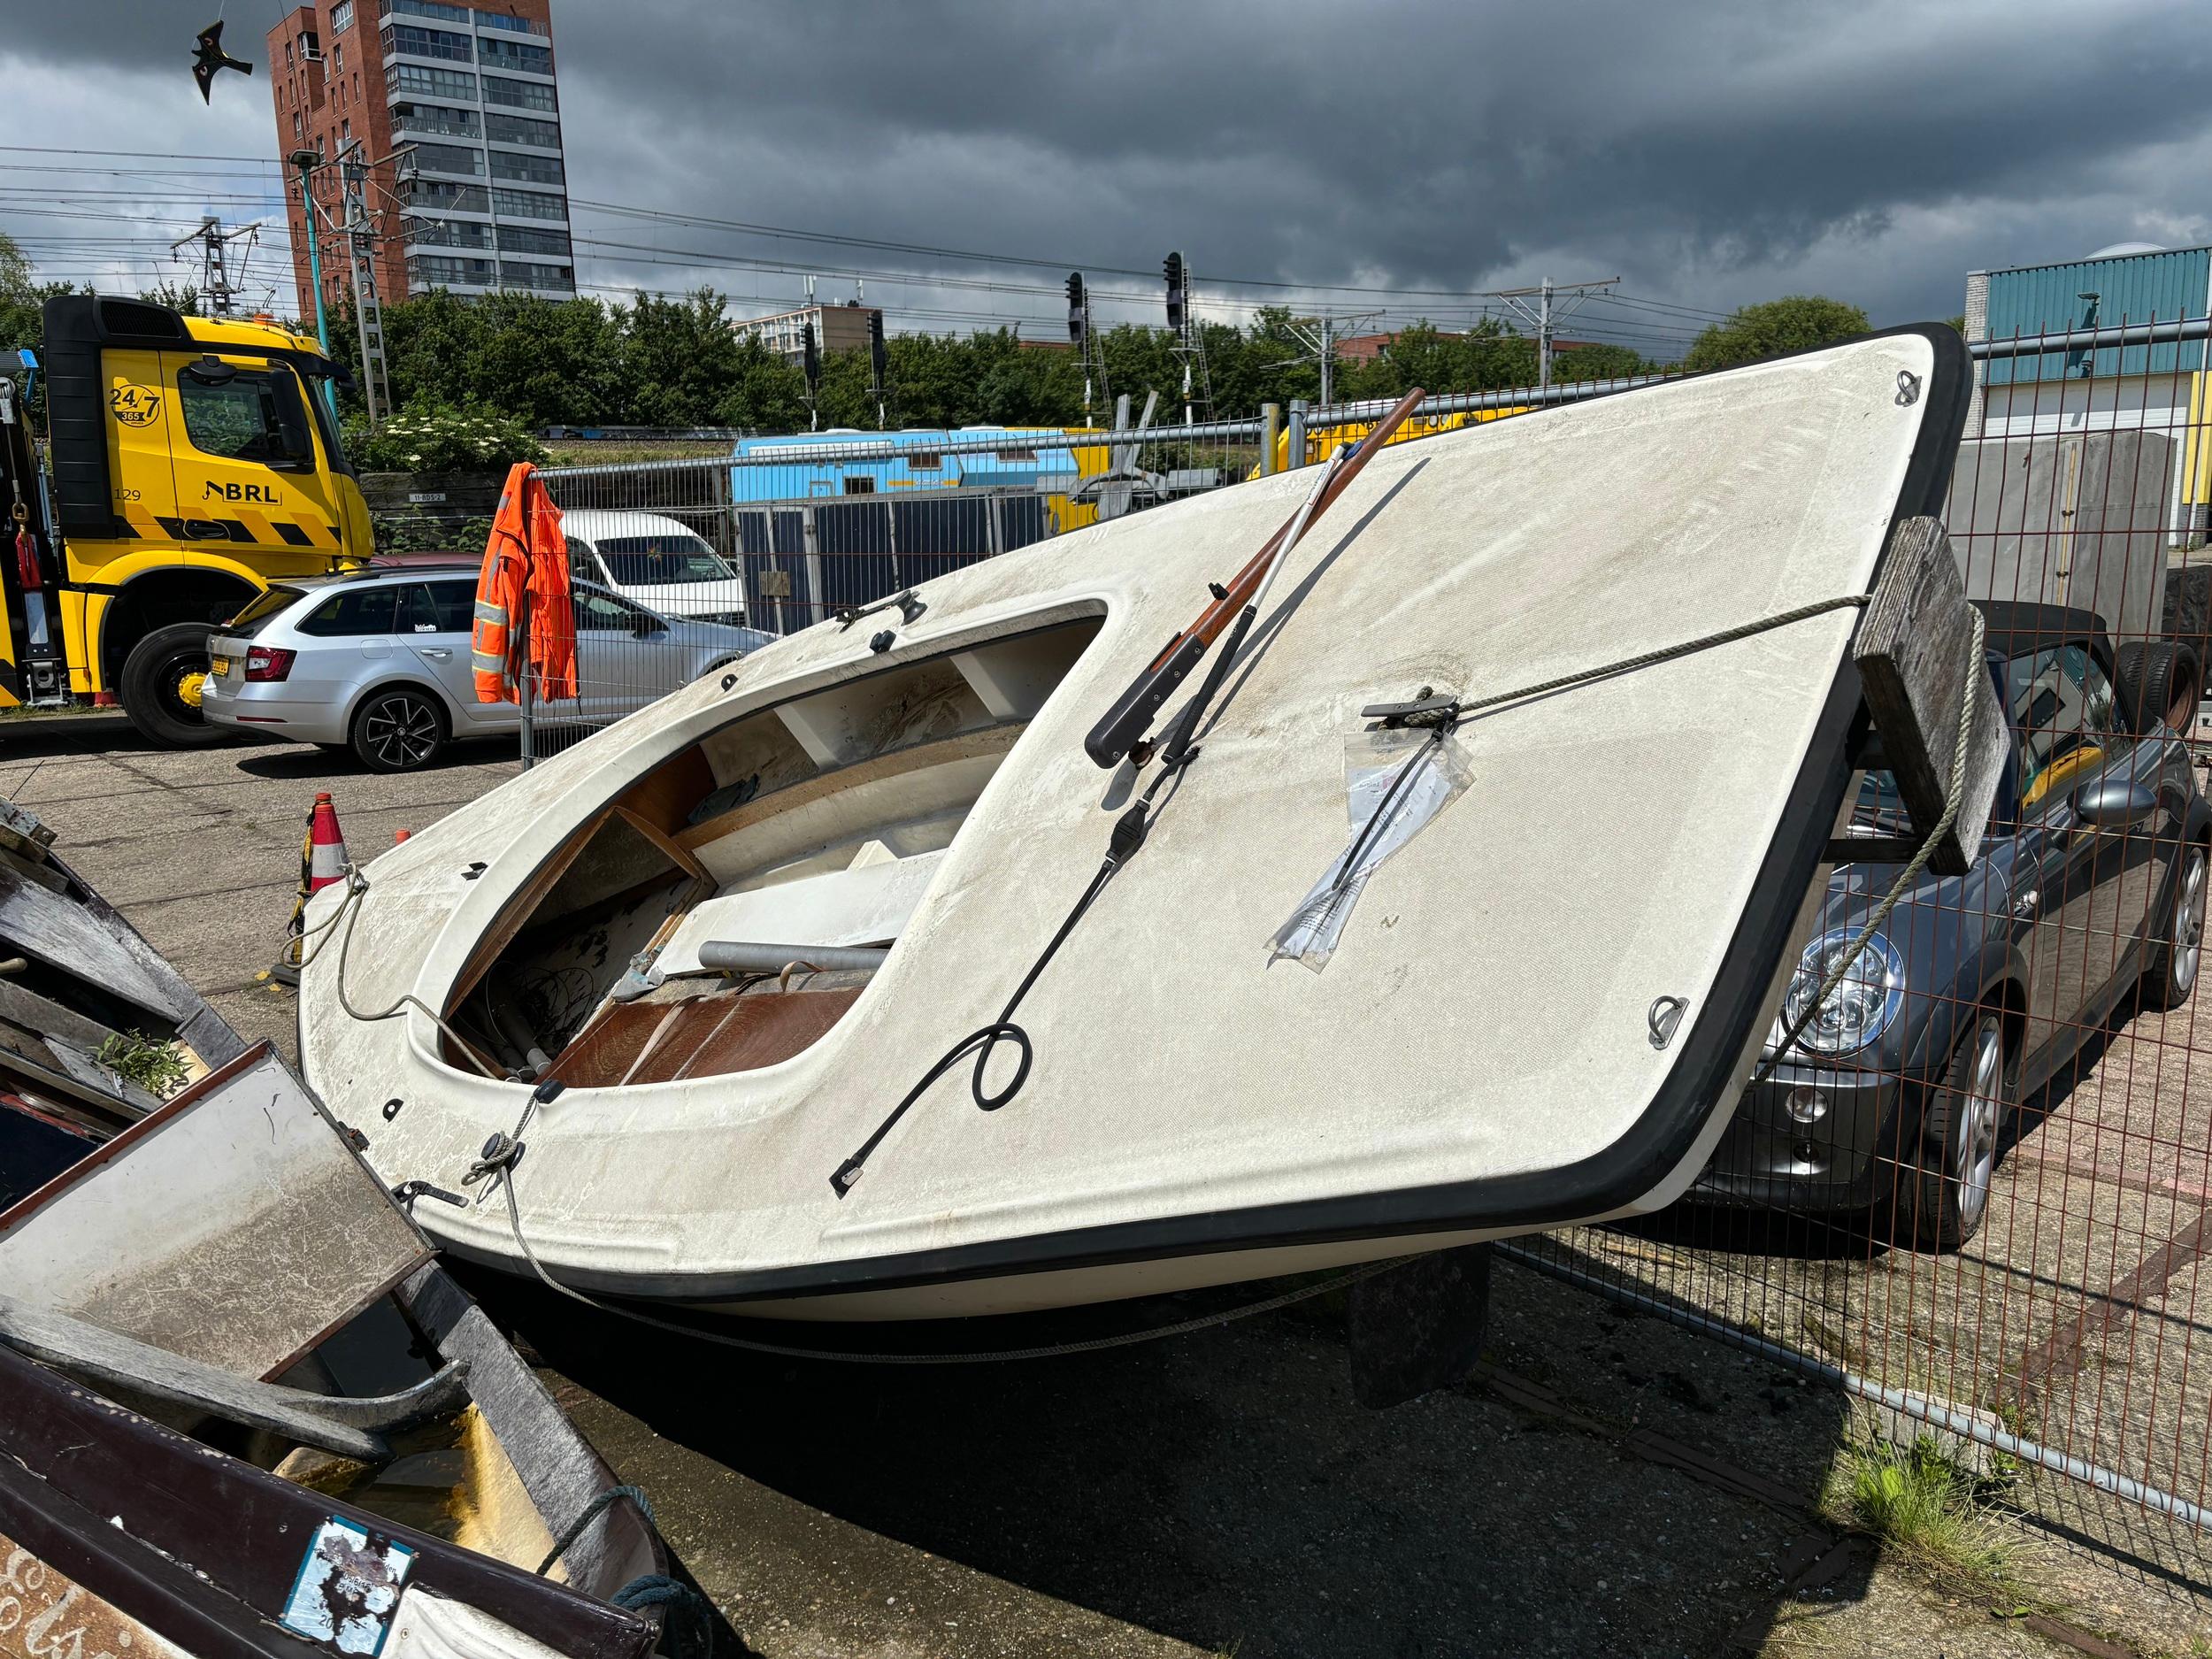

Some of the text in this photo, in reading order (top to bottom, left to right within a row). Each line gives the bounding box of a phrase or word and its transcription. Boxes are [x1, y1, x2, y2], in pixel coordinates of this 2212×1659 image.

[114, 488, 141, 501] 129
[226, 482, 279, 503] BRL
[319, 1614, 347, 1634] 201
